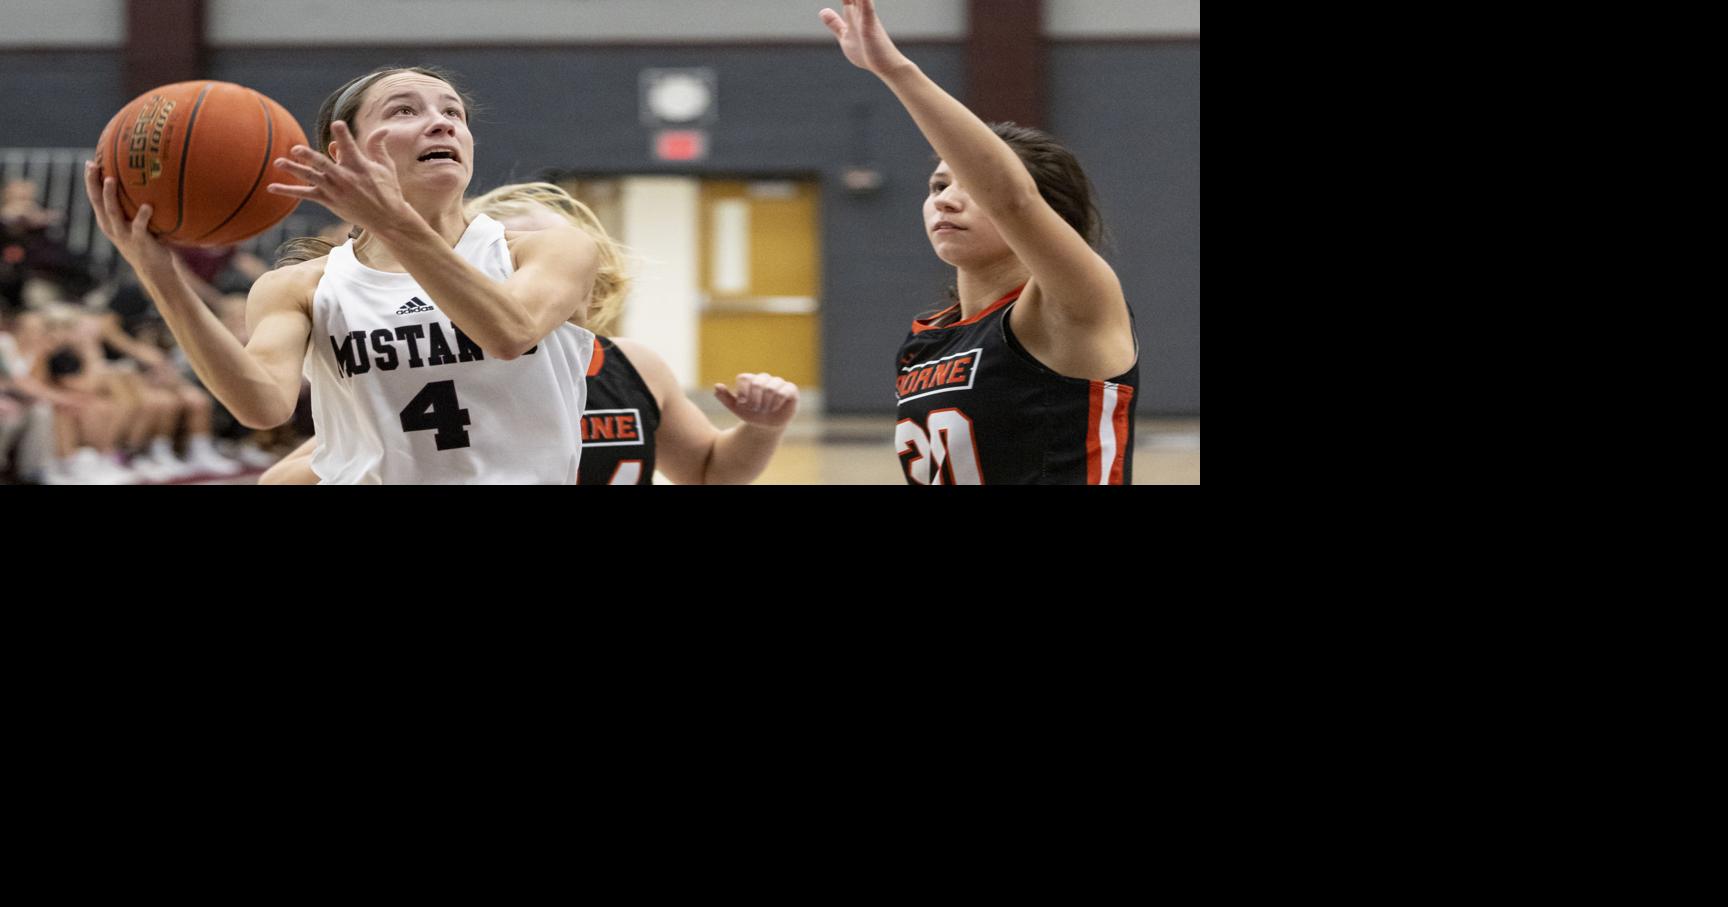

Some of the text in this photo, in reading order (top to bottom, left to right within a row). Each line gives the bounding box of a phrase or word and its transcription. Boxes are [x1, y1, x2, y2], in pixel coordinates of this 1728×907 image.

[396, 305, 435, 315] adidas
[330, 321, 538, 379] MUSTAN
[400, 379, 471, 451] 4
